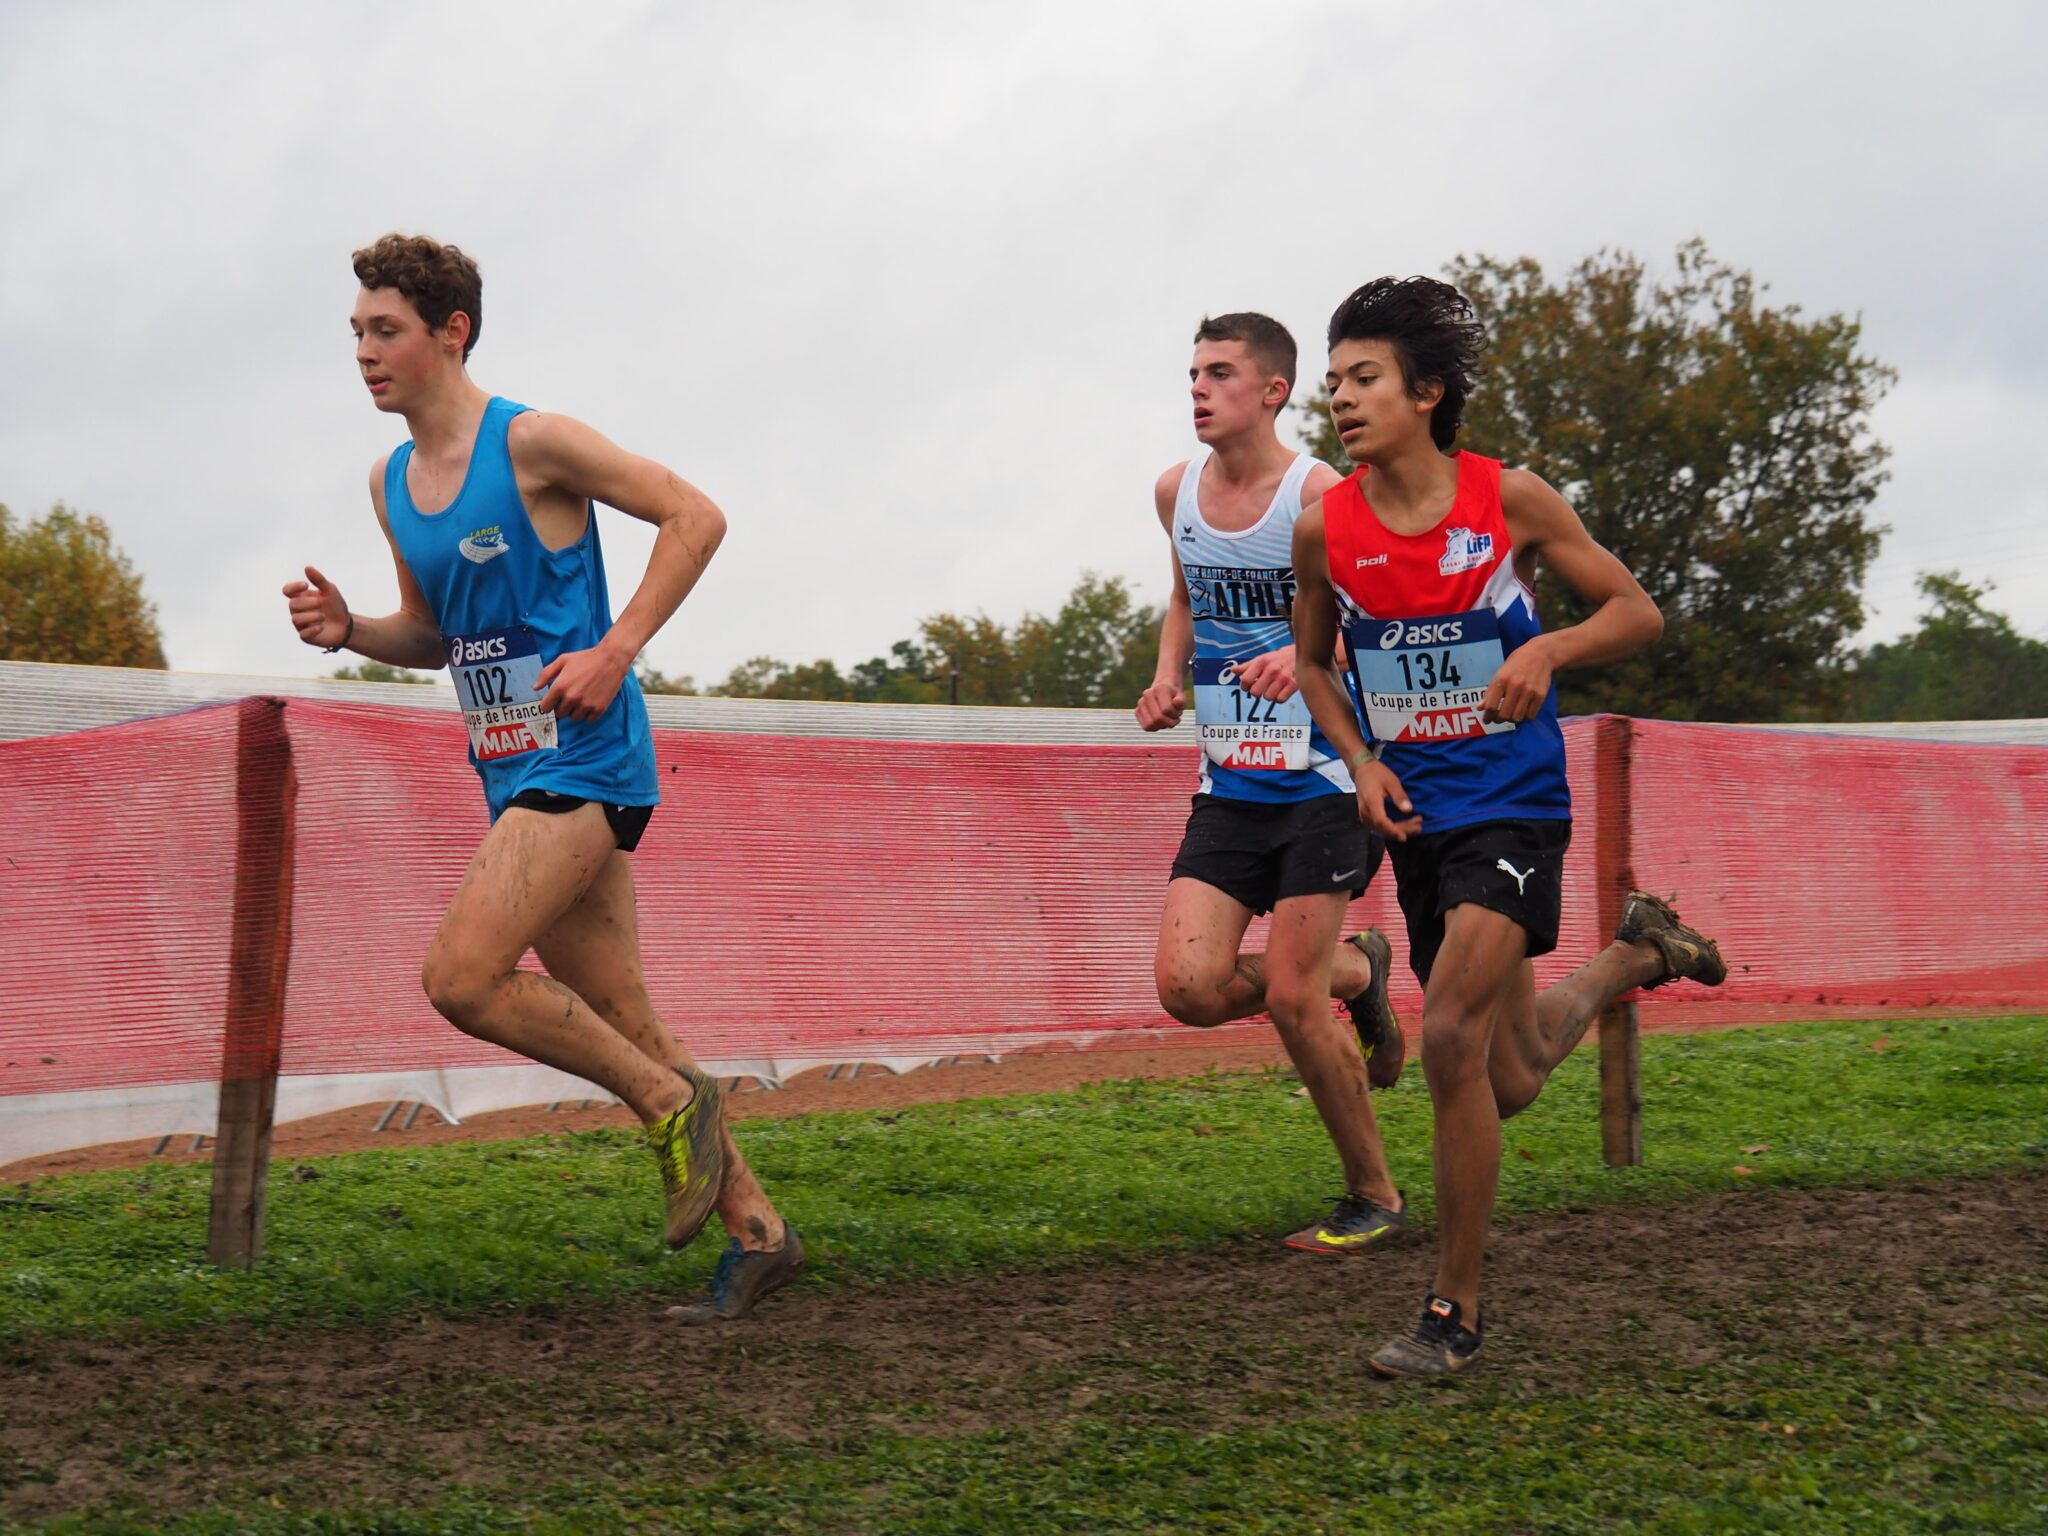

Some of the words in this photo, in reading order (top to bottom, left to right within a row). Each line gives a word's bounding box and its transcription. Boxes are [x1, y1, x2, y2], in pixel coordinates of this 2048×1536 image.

[1356, 554, 1388, 569] poli
[1201, 567, 1279, 581] HAUTS-DE-FRANCE
[1396, 650, 1461, 691] 134
[463, 666, 513, 707] 102
[1231, 688, 1277, 723] 122
[1371, 692, 1413, 713] Coupe
[1420, 692, 1437, 708] de
[485, 707, 499, 724] de
[1409, 713, 1476, 738] MAIF
[483, 728, 533, 755] MAIF
[1202, 725, 1239, 742] Coupe
[1244, 726, 1258, 739] de
[1262, 725, 1302, 739] France
[1231, 746, 1283, 766] MAIF
